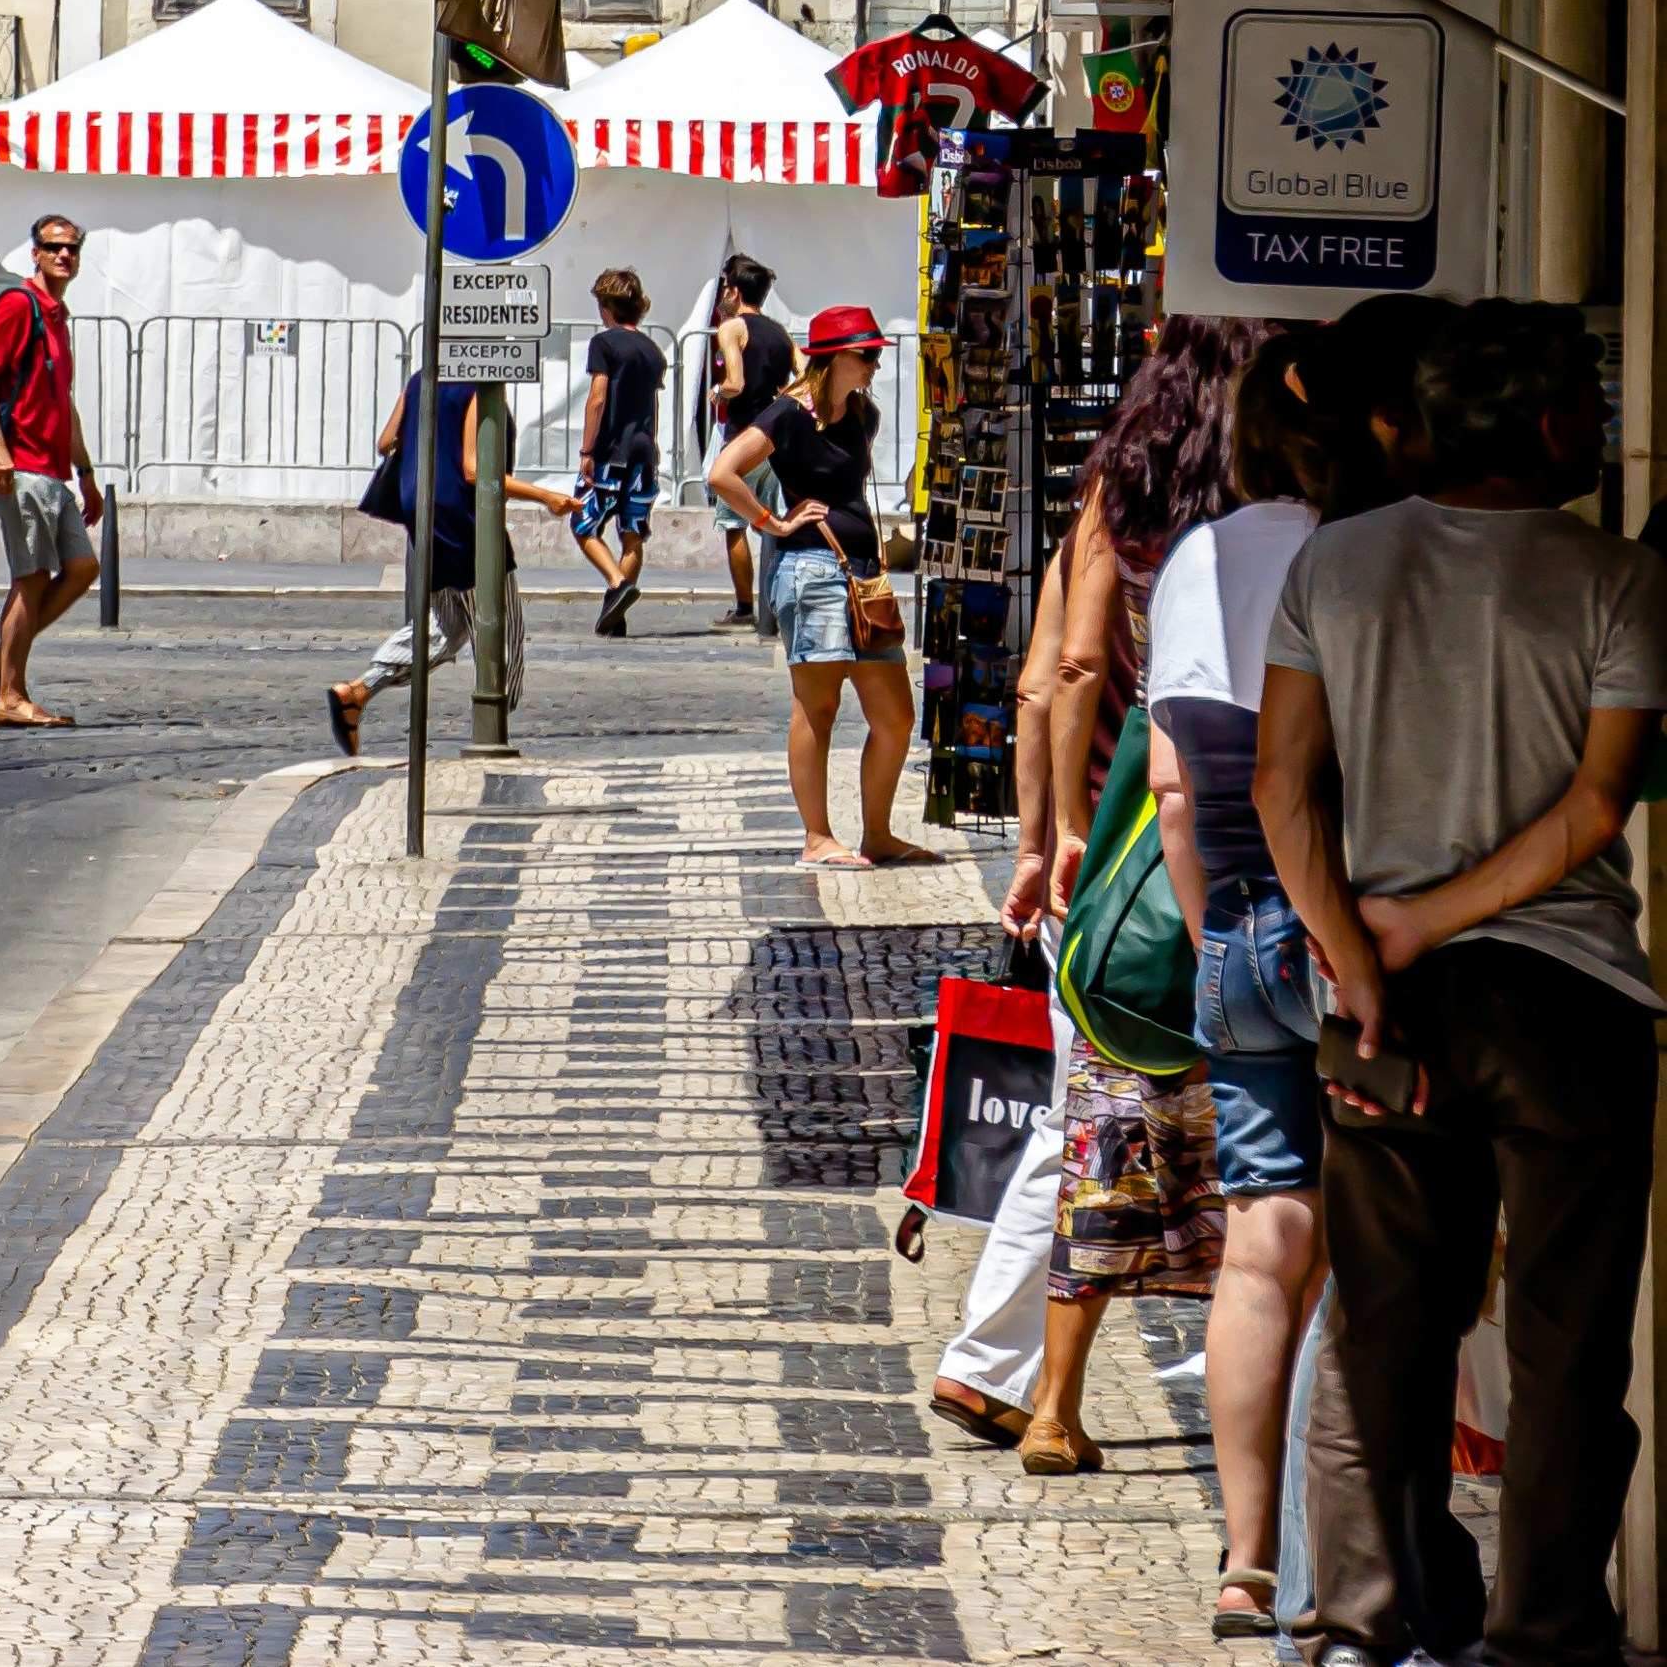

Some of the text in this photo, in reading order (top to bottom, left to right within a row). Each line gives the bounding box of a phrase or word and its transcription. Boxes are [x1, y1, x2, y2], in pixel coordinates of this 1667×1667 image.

[891, 50, 979, 80] RONALDO
[1033, 157, 1082, 171] Lisboa
[1247, 170, 1409, 200] Global Blue
[1247, 232, 1405, 268] TAX FREE
[453, 274, 527, 290] EXCEPTO
[443, 305, 539, 325] RESIDENTES
[449, 344, 522, 359] EXCEPTO
[438, 362, 535, 379] ELÉCTRICOS
